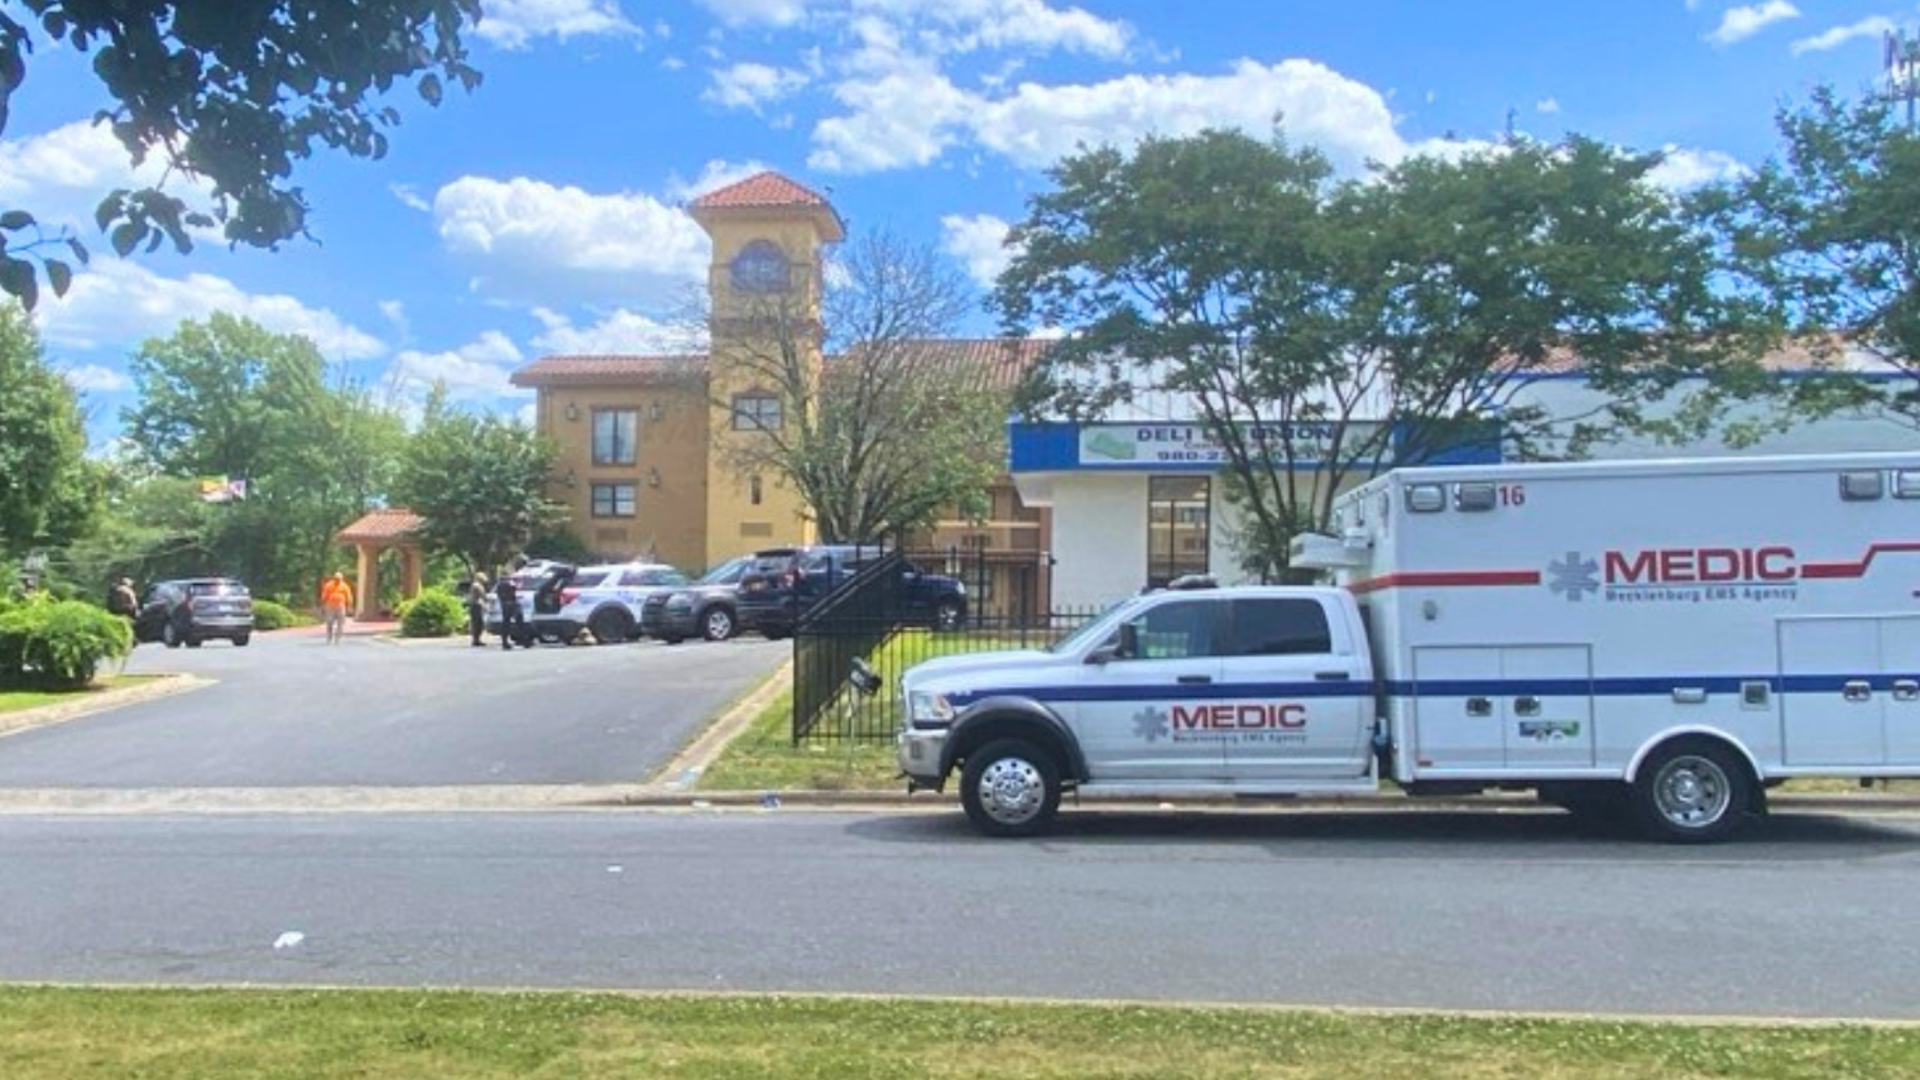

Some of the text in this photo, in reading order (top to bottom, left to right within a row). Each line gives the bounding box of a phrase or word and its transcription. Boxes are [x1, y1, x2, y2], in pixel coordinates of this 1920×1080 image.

[1137, 428, 1193, 441] DELI
[1250, 427, 1333, 440] UNION
[1499, 485, 1526, 506] 16
[1605, 546, 1796, 583] MEDIC
[1705, 587, 1737, 600] EMS
[1743, 587, 1798, 601] Agency
[1171, 704, 1307, 729] MEDIC
